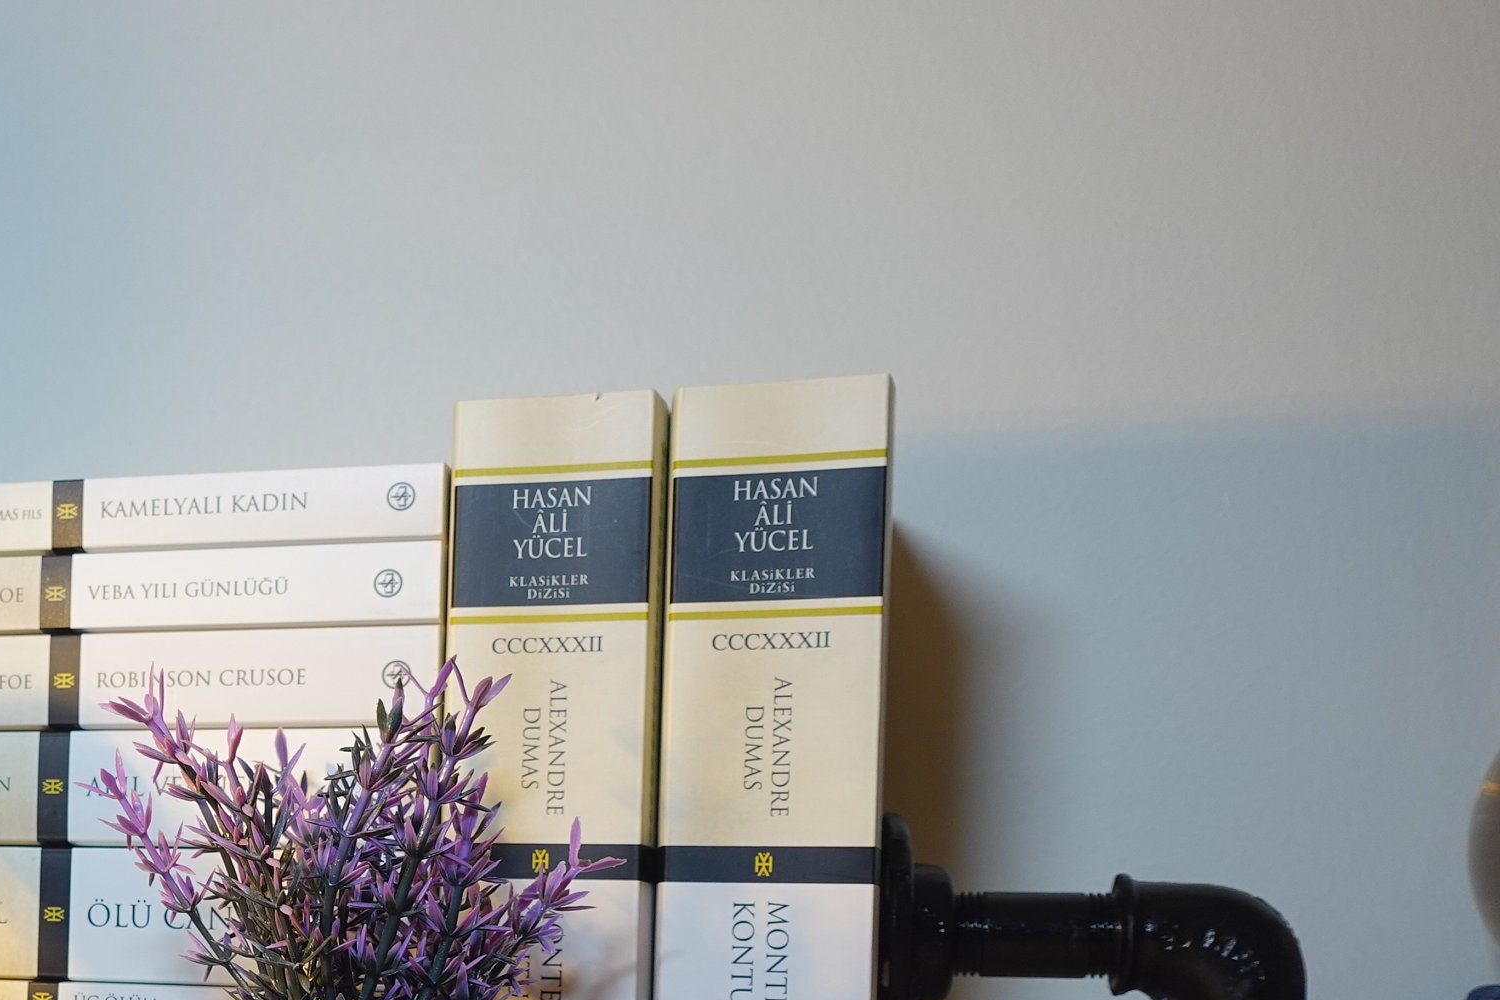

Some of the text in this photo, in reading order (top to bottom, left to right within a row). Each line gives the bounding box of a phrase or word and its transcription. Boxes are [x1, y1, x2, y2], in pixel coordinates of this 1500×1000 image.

[512, 486, 592, 510] HASAN
[733, 476, 819, 501] HASAN
[22, 508, 42, 521] FILS
[100, 491, 309, 519] KAMELYALI KADIN
[754, 500, 793, 526] ÂLİ
[532, 509, 568, 533] ÂLİ
[513, 533, 588, 560] YÜCEL
[734, 526, 814, 553] YÜCEL
[88, 577, 289, 600] VEBA YILI GÜNLÜĞÜ
[491, 635, 604, 655] CCCXXXII
[712, 631, 832, 652] CCCXXXII
[219, 668, 307, 687] CRUSOE
[521, 707, 542, 790] DUMAS
[546, 680, 567, 816] ALEXANDRE
[743, 706, 764, 791] DUMAS
[769, 677, 793, 817] ALEXANDRE
[88, 898, 151, 929] ÖLÜ
